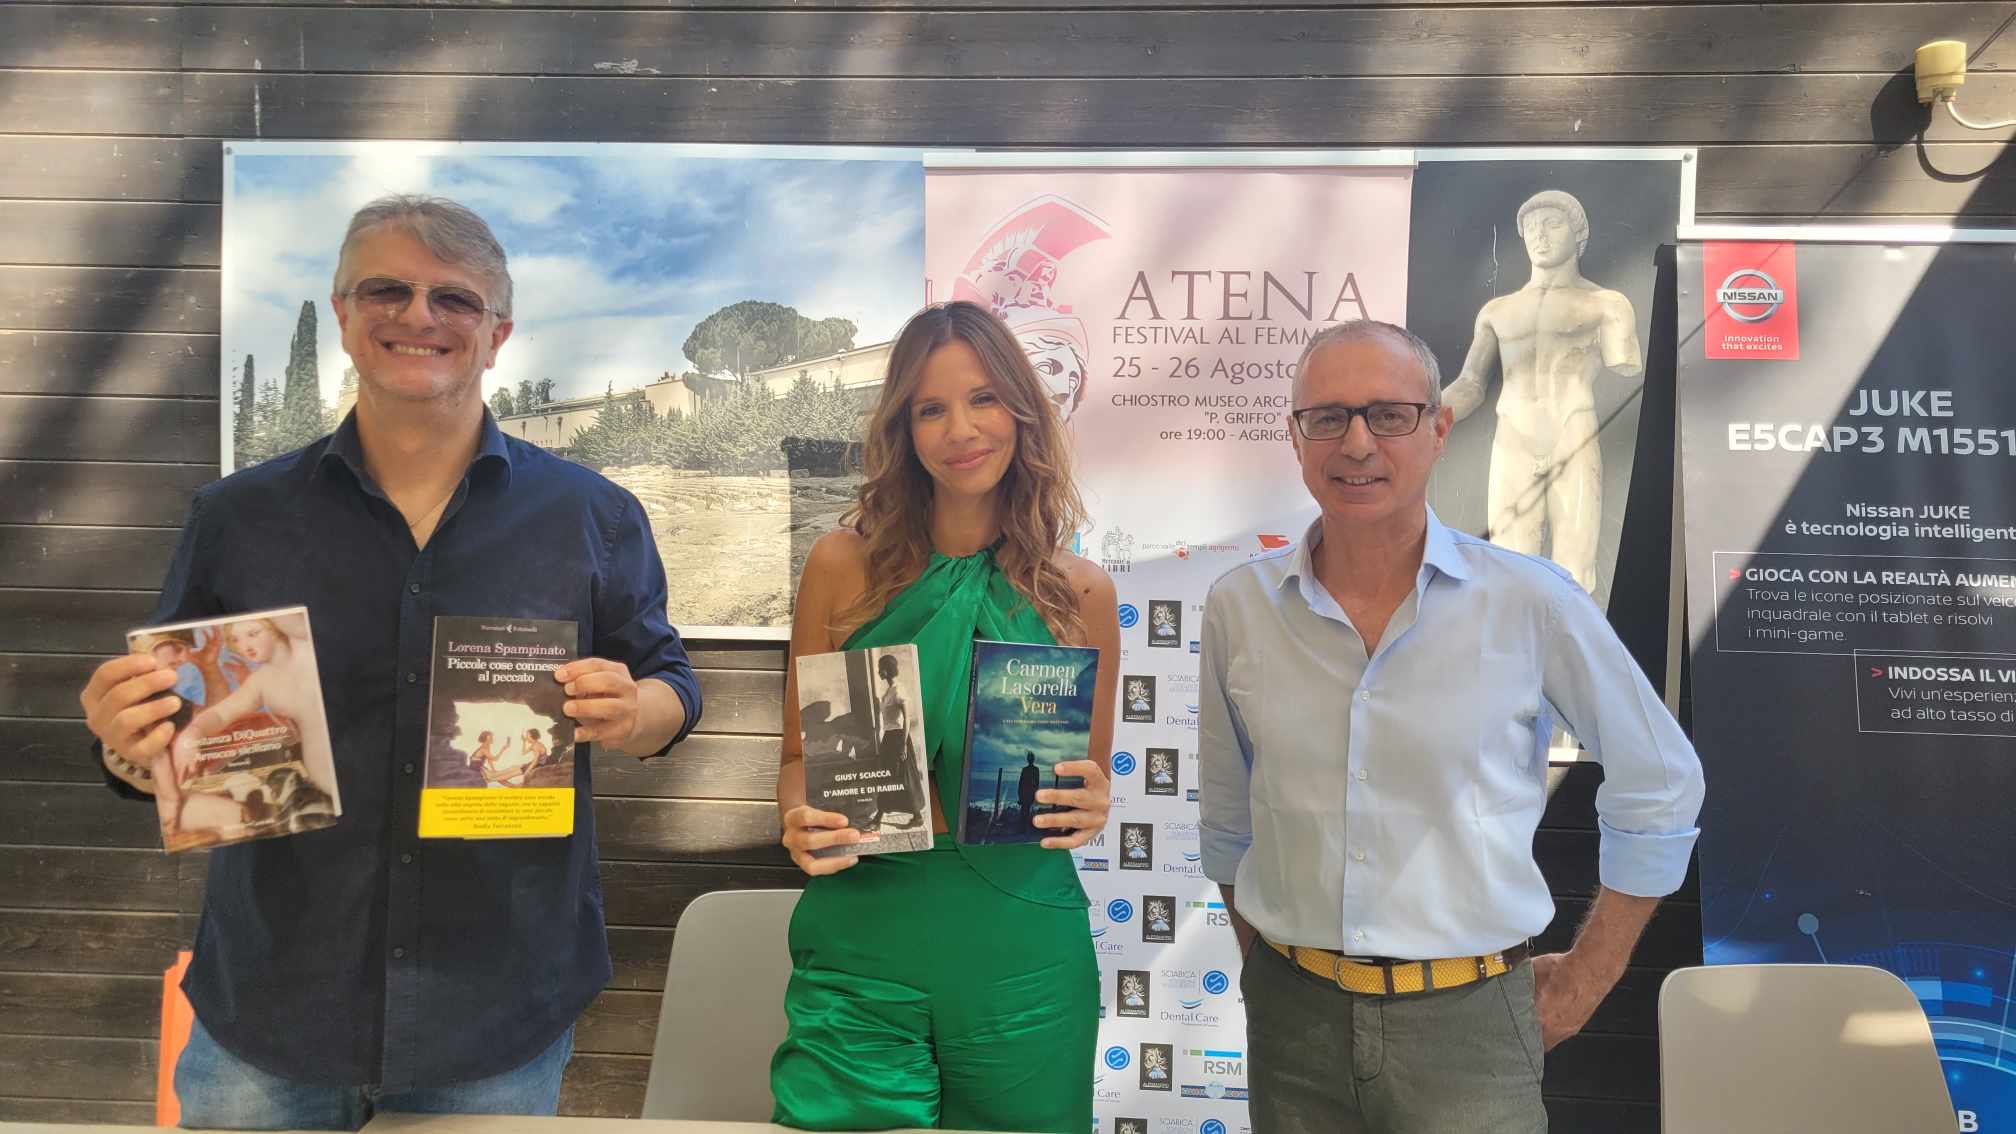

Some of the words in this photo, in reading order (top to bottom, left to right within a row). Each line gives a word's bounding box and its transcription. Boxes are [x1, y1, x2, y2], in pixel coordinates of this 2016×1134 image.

[1113, 270, 1372, 322] ATENA
[1722, 291, 1778, 301] NISSAN
[1112, 326, 1210, 345] FESTIVAL
[1219, 326, 1247, 345] AL
[1255, 327, 1324, 345] FEMM
[1745, 343, 1783, 351] excites
[1112, 357, 1142, 378] 25
[1169, 357, 1200, 378] 26
[1111, 394, 1190, 408] CHIOSTRO
[1194, 395, 1248, 408] MUSEO
[1849, 389, 1954, 417] JUKE
[1225, 412, 1282, 425] GRIFFO"
[1160, 430, 1182, 441] ore
[1186, 429, 1226, 441] 19:00
[1727, 423, 1885, 454] E5CAP3
[1897, 426, 2016, 456] M1551
[1846, 502, 1914, 519] Nissan
[1919, 505, 1971, 519] JUKE
[1785, 520, 1797, 535] è
[1800, 521, 1910, 541] tecnologia
[1745, 568, 1804, 583] GIOCA
[1808, 569, 1848, 583] CON
[1853, 571, 1877, 585] LA
[1882, 569, 1951, 587] REALTÀ
[1745, 588, 1790, 602] Trova
[1794, 589, 1806, 602] le
[1811, 590, 1854, 603] icone
[1858, 592, 1952, 606] posizionate
[1957, 594, 1980, 607] sul
[1747, 608, 1832, 623] inquadrale
[1836, 611, 1866, 623] con
[1870, 610, 1878, 623] il
[1882, 611, 1930, 624] tablet
[1933, 614, 1944, 625] e
[1948, 613, 1993, 626] risolvi
[1756, 627, 1848, 643] mini-game.
[447, 641, 492, 653] Lorena
[494, 642, 566, 657] Spampinato
[447, 657, 487, 670] Piccole
[488, 661, 514, 670] cose
[515, 662, 561, 672] conness
[1006, 658, 1076, 678] Carmen
[478, 670, 490, 682] al
[492, 673, 535, 685] peccato
[1888, 666, 1975, 682] INDOSSA
[1979, 669, 1996, 683] IL
[1001, 677, 1078, 697] Lasorella
[1888, 687, 1917, 701] Vivi
[1021, 695, 1057, 714] Vera
[1890, 707, 1912, 720] ad
[1916, 707, 1947, 721] alto
[1950, 709, 1997, 722] tasso
[2000, 710, 2015, 723] di
[834, 773, 858, 782] GIUSY
[859, 770, 892, 780] SCIACCA
[823, 787, 859, 798] D'AMORE
[867, 786, 876, 794] DI
[877, 783, 905, 793] RABBIA
[1163, 863, 1197, 873] Dental
[1206, 912, 1231, 926] RS
[1100, 941, 1124, 952] Care
[1160, 1011, 1194, 1022] Dental
[1195, 1012, 1219, 1023] Care
[1203, 1060, 1242, 1076] RSM
[1097, 1088, 1121, 1099] Care
